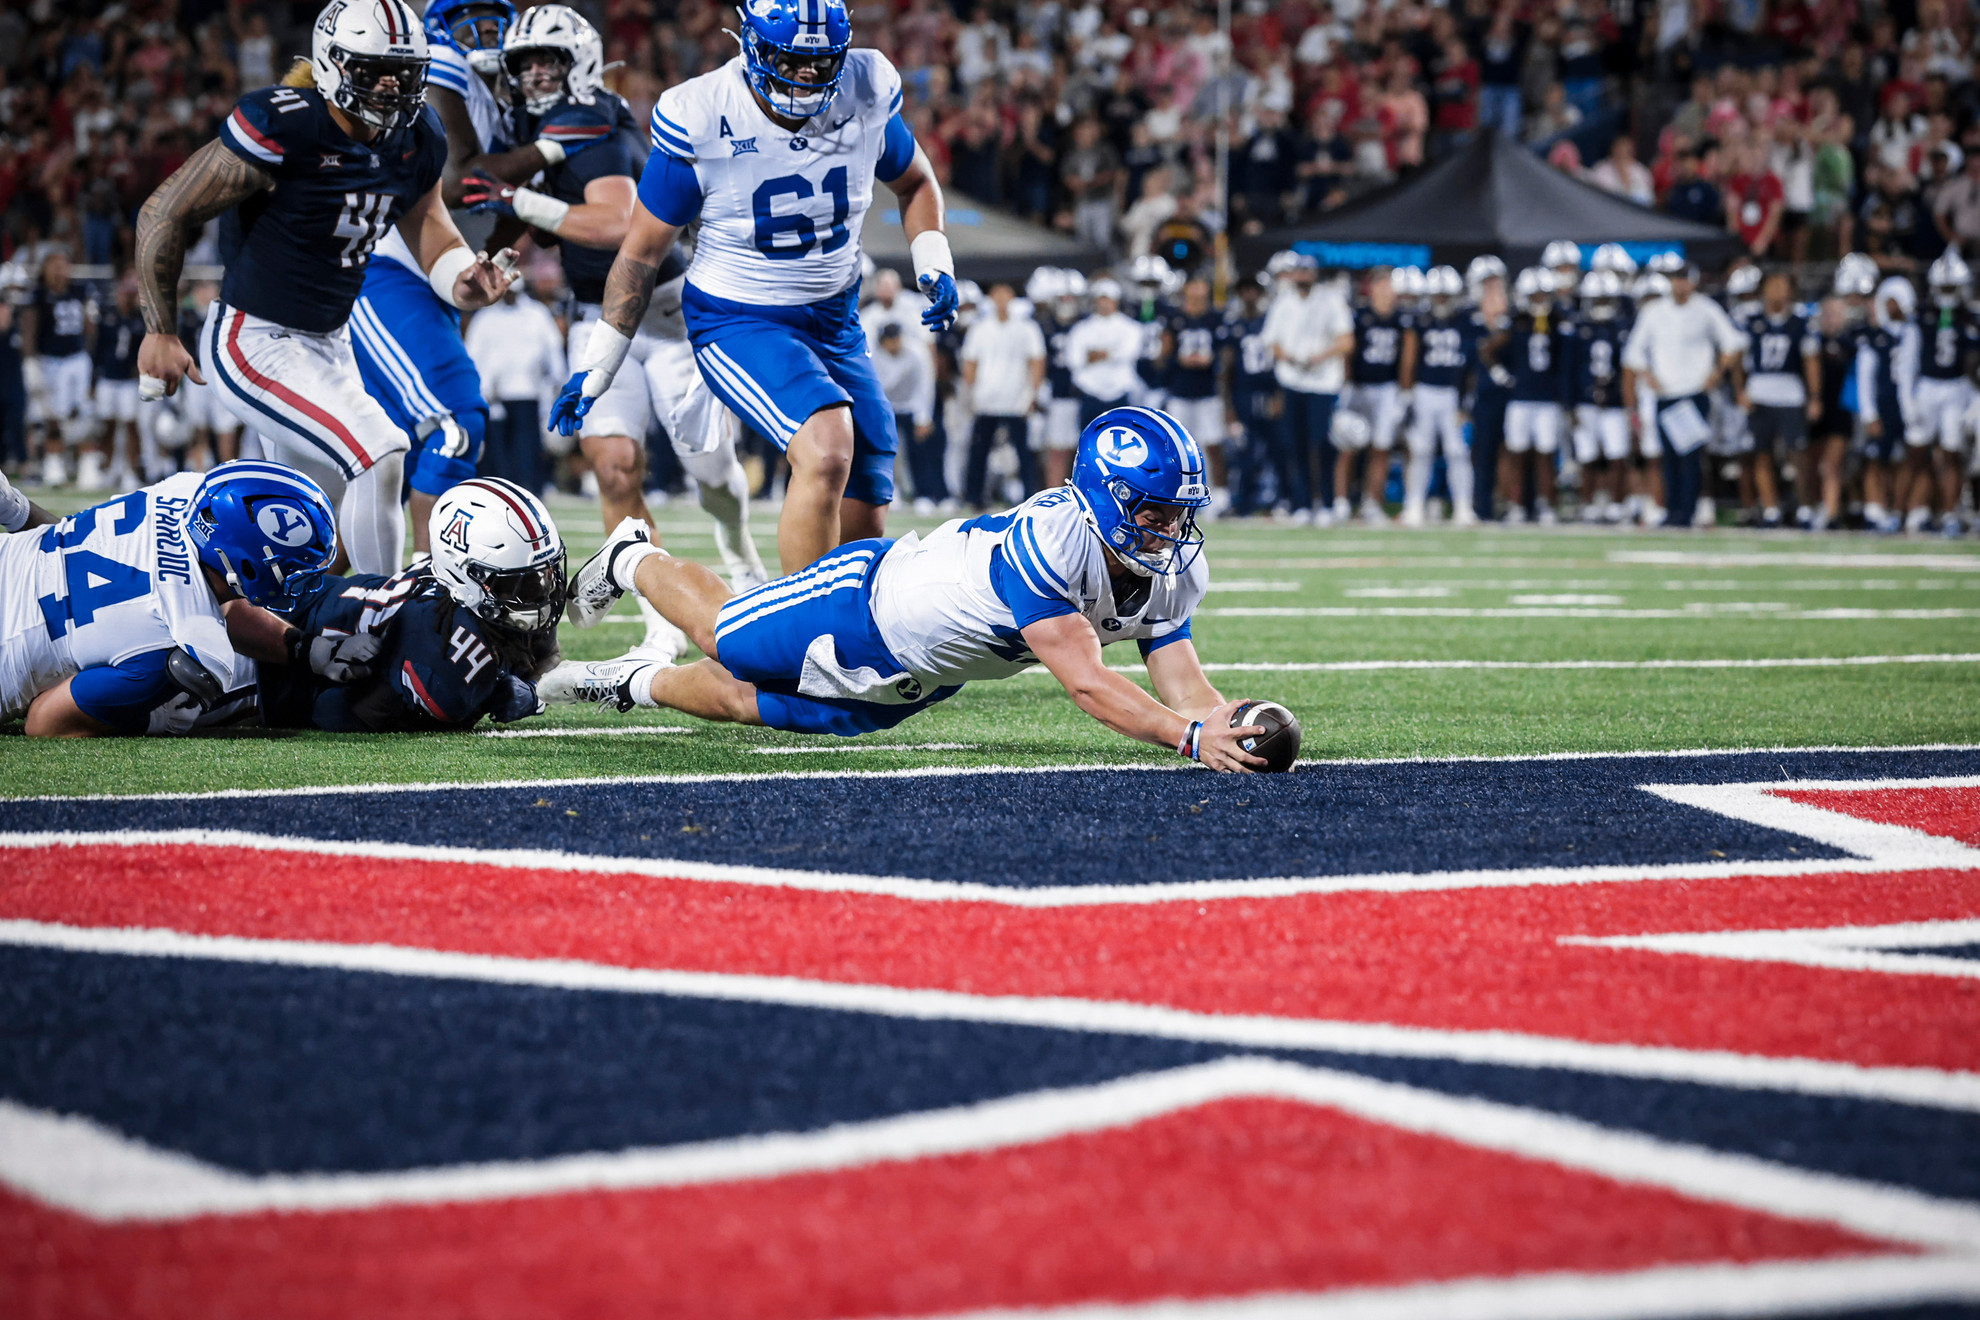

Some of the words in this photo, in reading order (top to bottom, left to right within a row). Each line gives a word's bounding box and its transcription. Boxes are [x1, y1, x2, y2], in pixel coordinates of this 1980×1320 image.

[804, 36, 821, 44] BYU
[270, 89, 309, 114] 41
[719, 115, 733, 138] A
[333, 193, 394, 268] 41
[752, 165, 850, 260] 61
[1106, 429, 1142, 461] Y
[1187, 486, 1200, 495] BYU
[156, 496, 191, 585] SFARCIOC
[270, 508, 307, 542] Y
[440, 508, 474, 554] A
[38, 490, 152, 642] 64
[449, 625, 493, 684] 44
